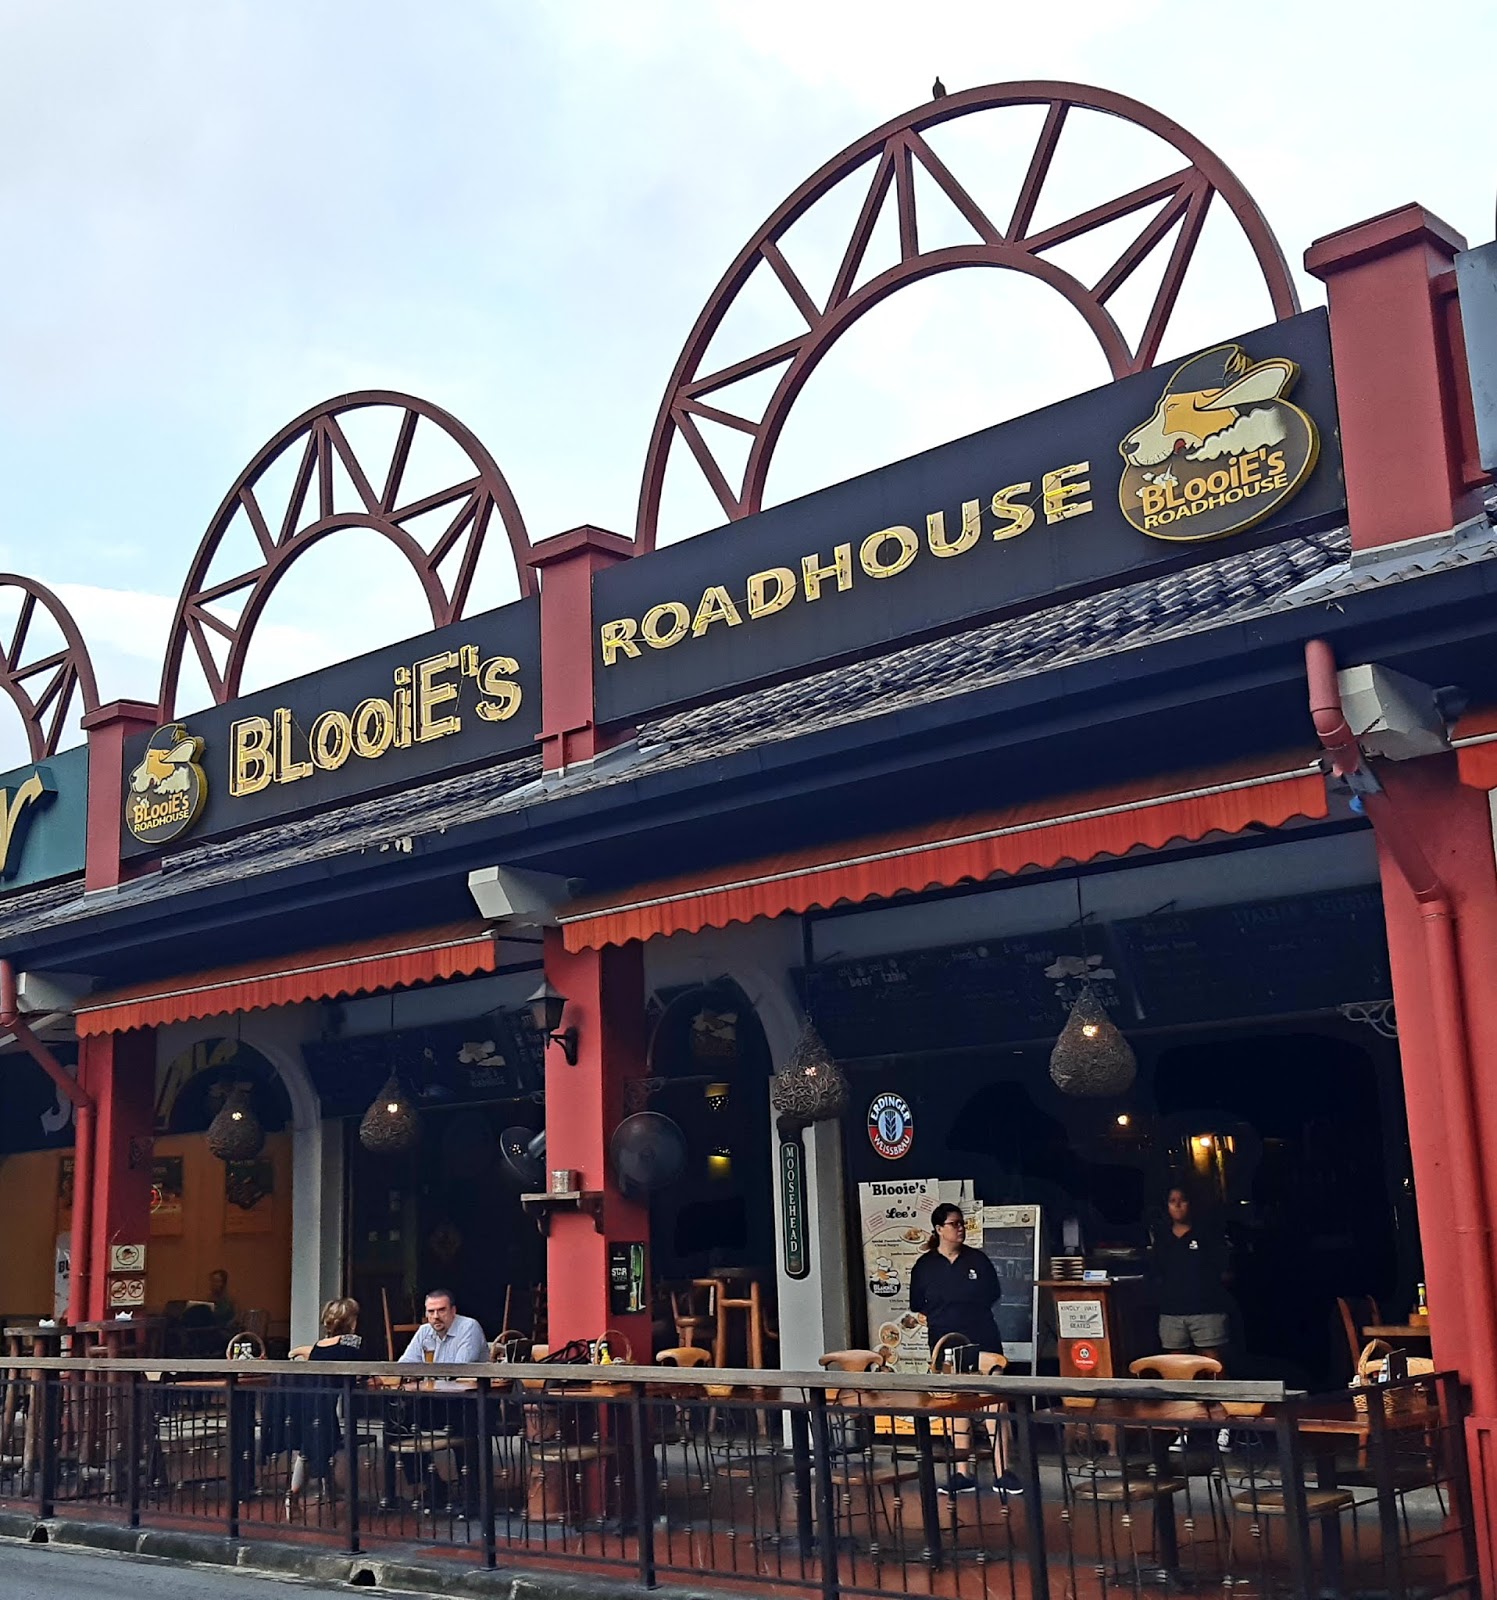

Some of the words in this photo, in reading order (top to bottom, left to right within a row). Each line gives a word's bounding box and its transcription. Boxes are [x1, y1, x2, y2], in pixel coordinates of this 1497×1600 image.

[1144, 473, 1289, 530] ROADHOUSE
[601, 461, 1094, 666] ROADHOUSE
[134, 809, 190, 833] ROADHOUSE
[870, 1095, 910, 1121] ERDINGER
[786, 1147, 798, 1252] MOOSEHEAD
[872, 1182, 926, 1196] Blooie's
[886, 1206, 917, 1219] Lee's
